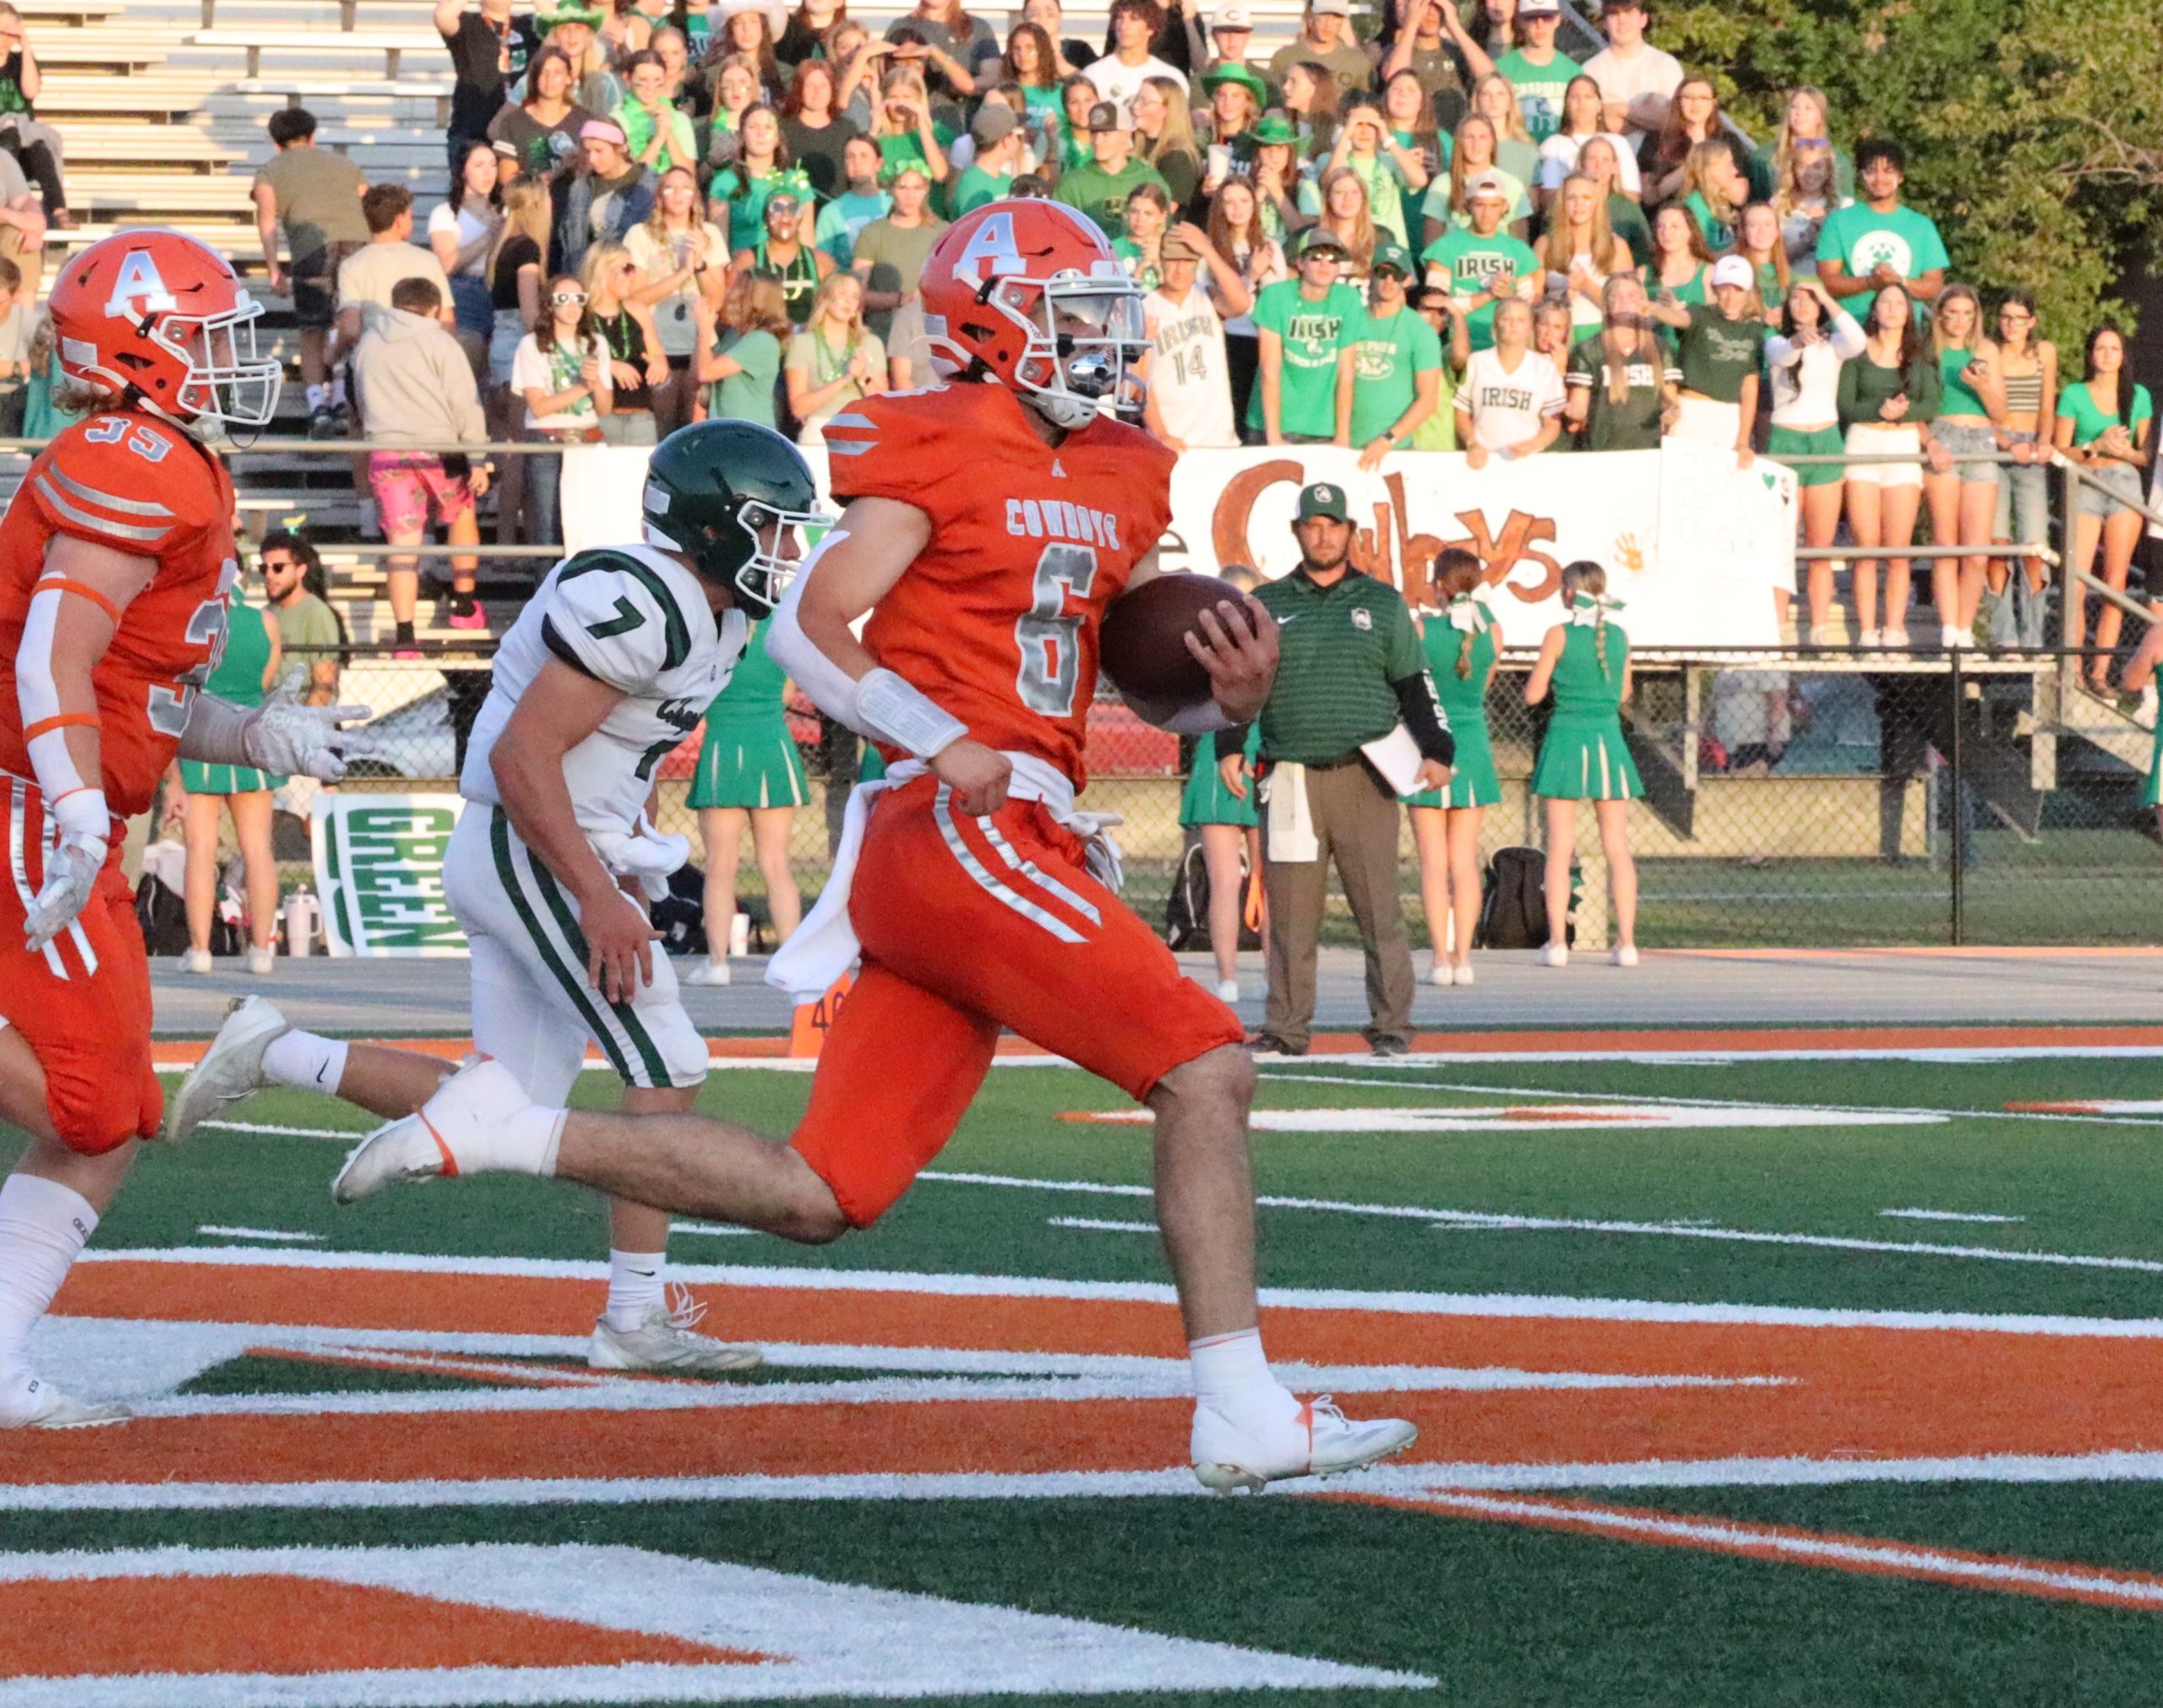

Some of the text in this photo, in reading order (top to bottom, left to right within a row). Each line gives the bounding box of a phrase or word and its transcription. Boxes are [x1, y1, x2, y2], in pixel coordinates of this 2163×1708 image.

[952, 212, 1027, 280] A
[1457, 256, 1517, 278] IRISH
[104, 251, 177, 318] A
[1155, 315, 1214, 356] IRISH
[1173, 345, 1207, 385] 14
[1482, 386, 1534, 411] IRISH
[1005, 498, 1120, 551] COWBOYS
[585, 596, 646, 640] 7
[1014, 541, 1099, 717] 6
[347, 808, 470, 948] GREEN
